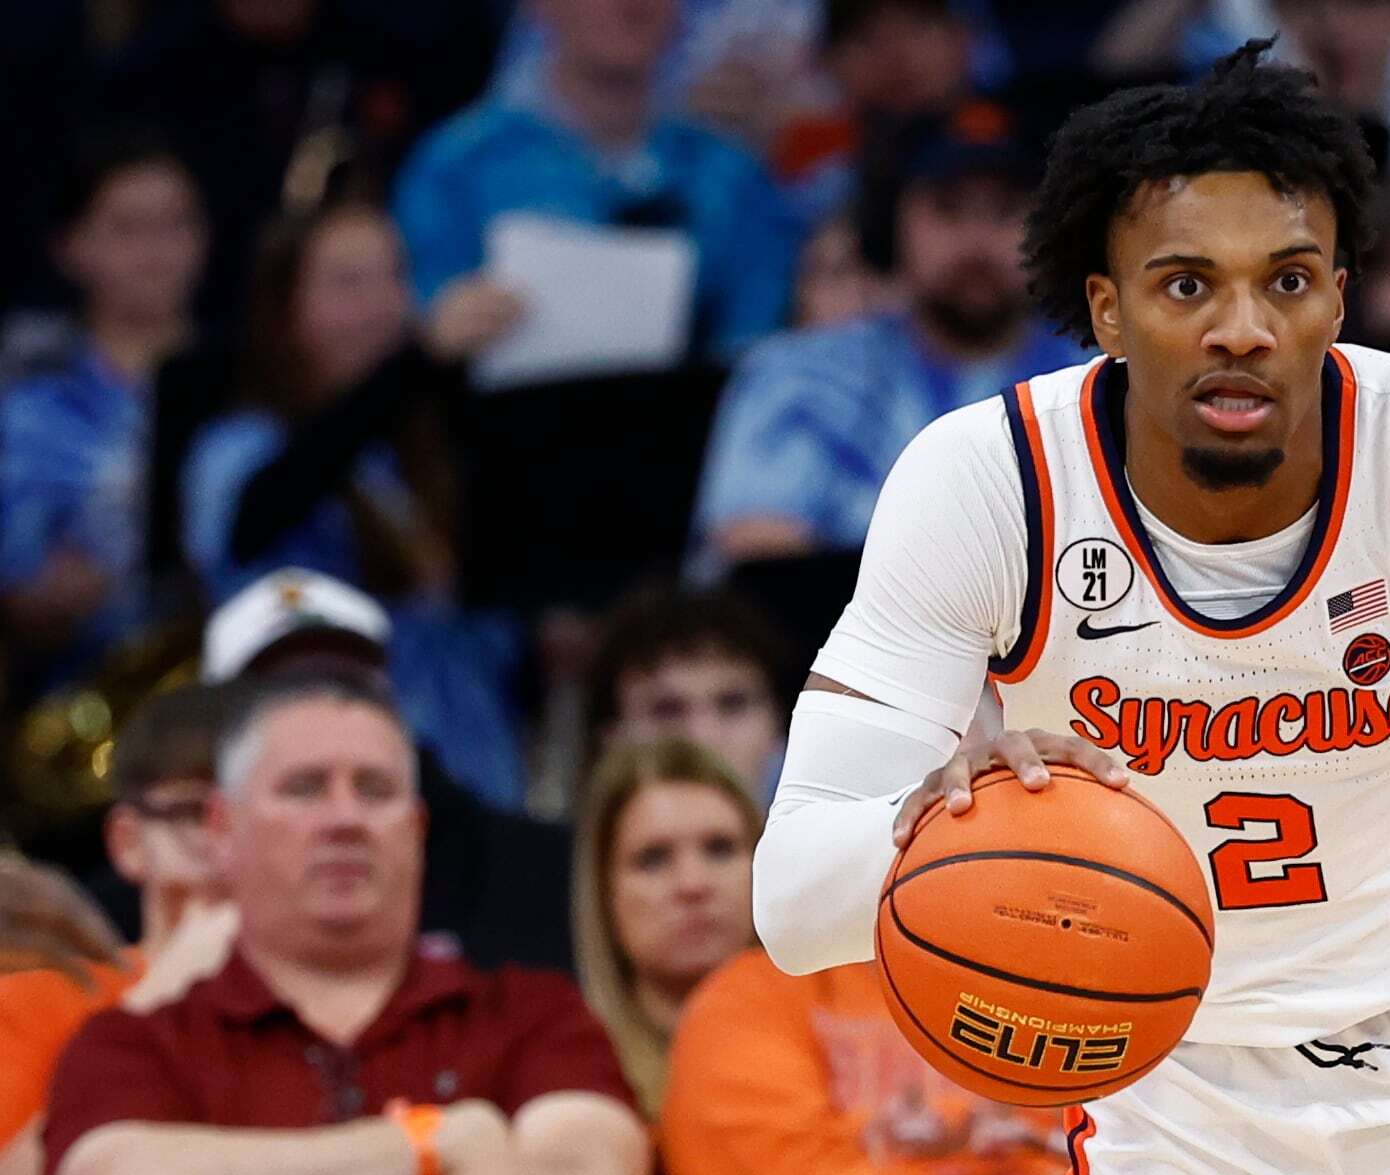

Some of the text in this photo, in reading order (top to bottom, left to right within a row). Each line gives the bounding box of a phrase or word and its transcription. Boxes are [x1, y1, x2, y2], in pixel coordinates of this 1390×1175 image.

[1083, 548, 1106, 569] LM
[1083, 571, 1106, 602] 21
[1352, 647, 1388, 667] ACC
[1204, 791, 1328, 910] 2
[959, 987, 1133, 1034] CHAMPIONSHIP
[949, 1002, 1130, 1073] ELITE
